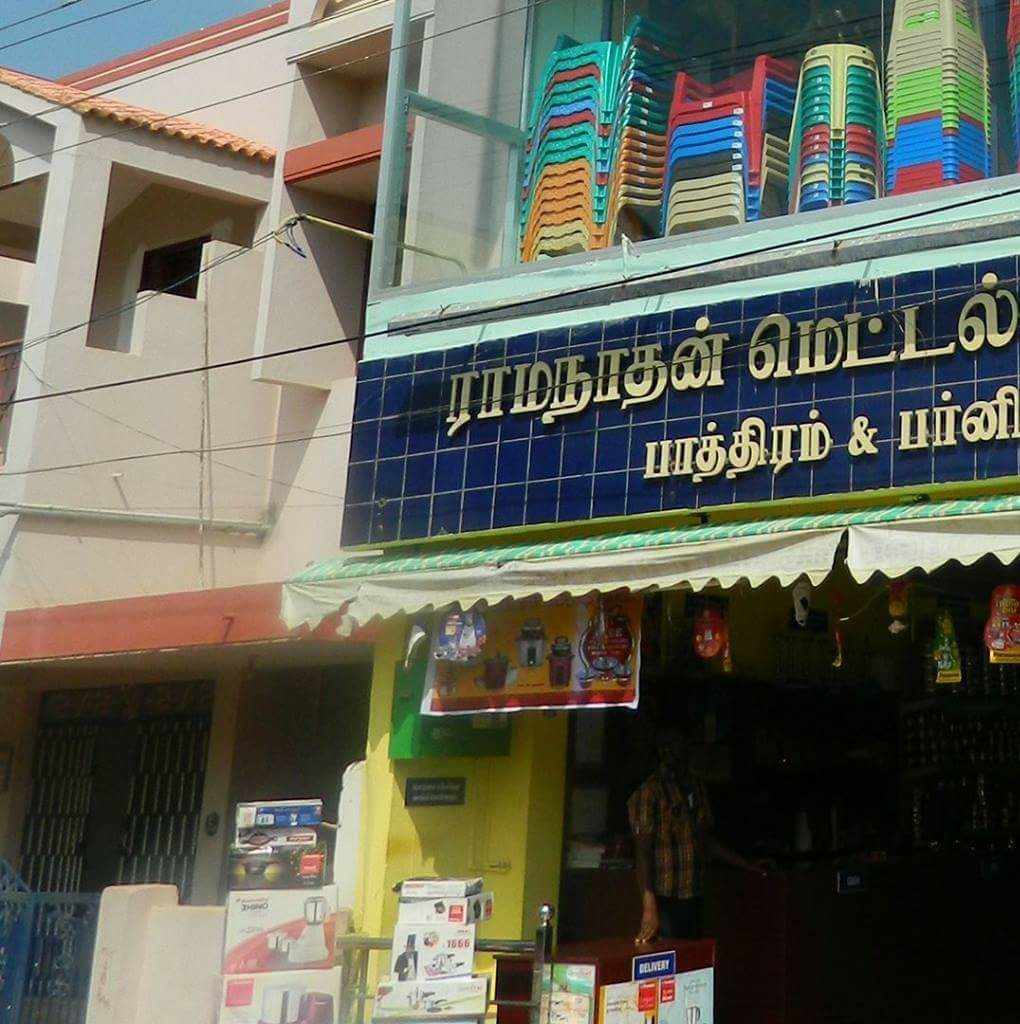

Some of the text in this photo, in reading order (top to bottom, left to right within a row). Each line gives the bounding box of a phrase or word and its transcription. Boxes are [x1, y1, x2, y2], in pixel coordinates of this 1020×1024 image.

[447, 317, 729, 435] ராமநாதன்
[750, 273, 1018, 379] மெட்டல்
[644, 409, 833, 482] பாத்திரம்
[848, 417, 878, 455] &
[639, 959, 670, 974] DELIVERY
